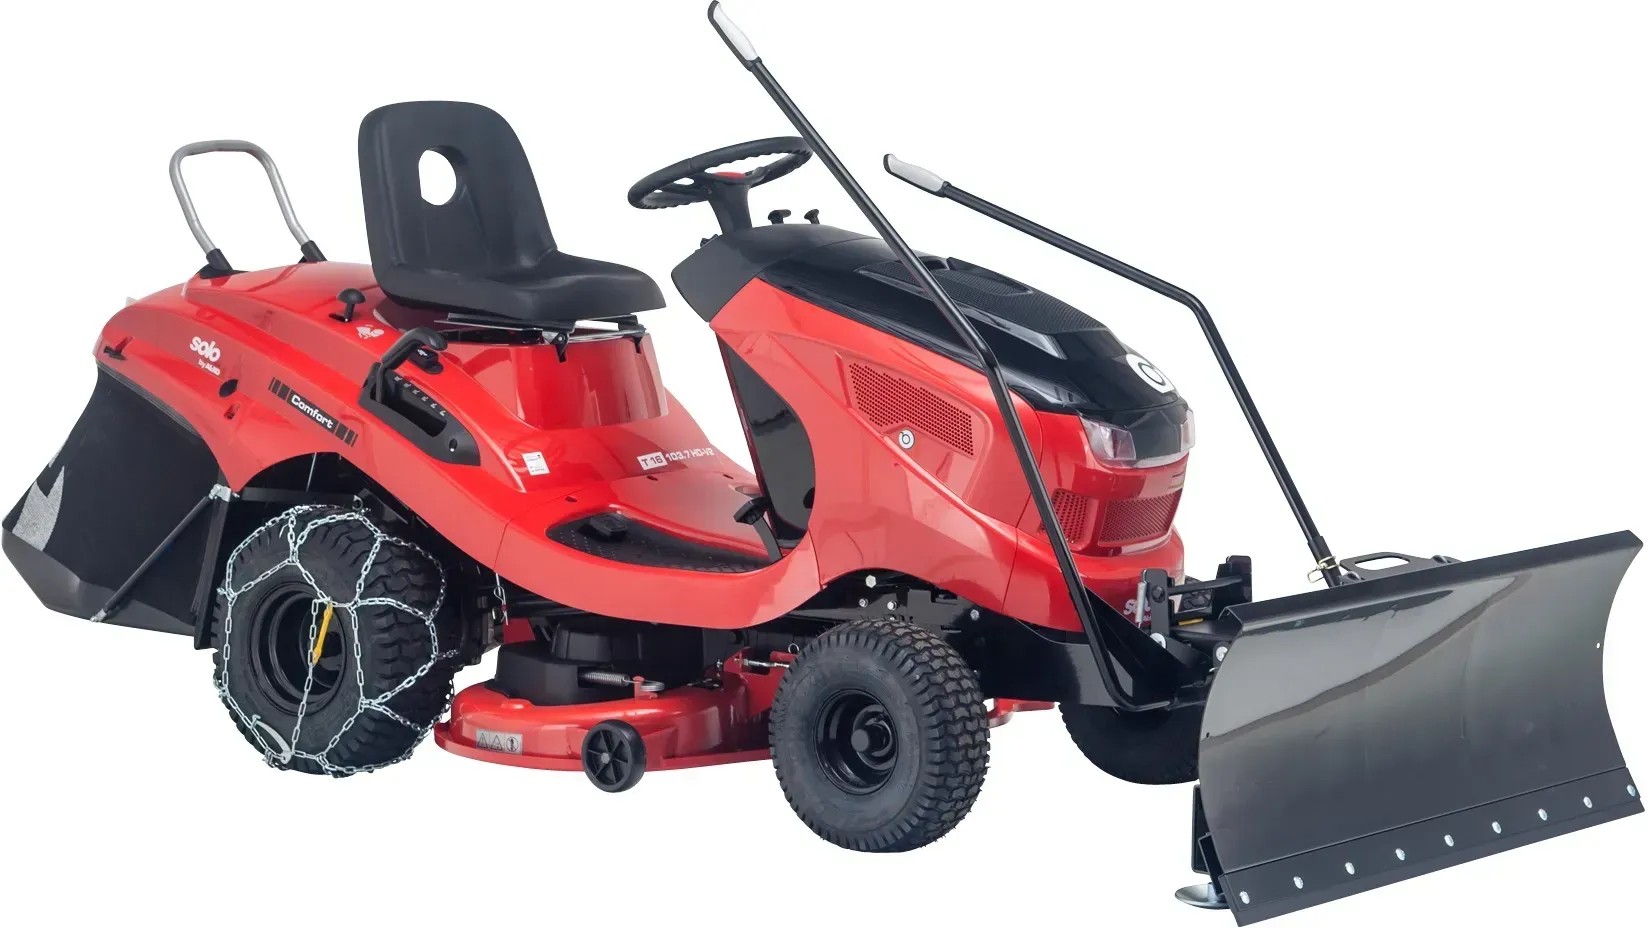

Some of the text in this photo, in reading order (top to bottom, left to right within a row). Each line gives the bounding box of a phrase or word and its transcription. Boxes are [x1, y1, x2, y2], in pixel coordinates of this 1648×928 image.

[190, 336, 221, 362] solo
[291, 394, 334, 429] Comfort
[641, 458, 649, 467] T
[651, 455, 663, 465] 16
[665, 450, 690, 462] 103.7
